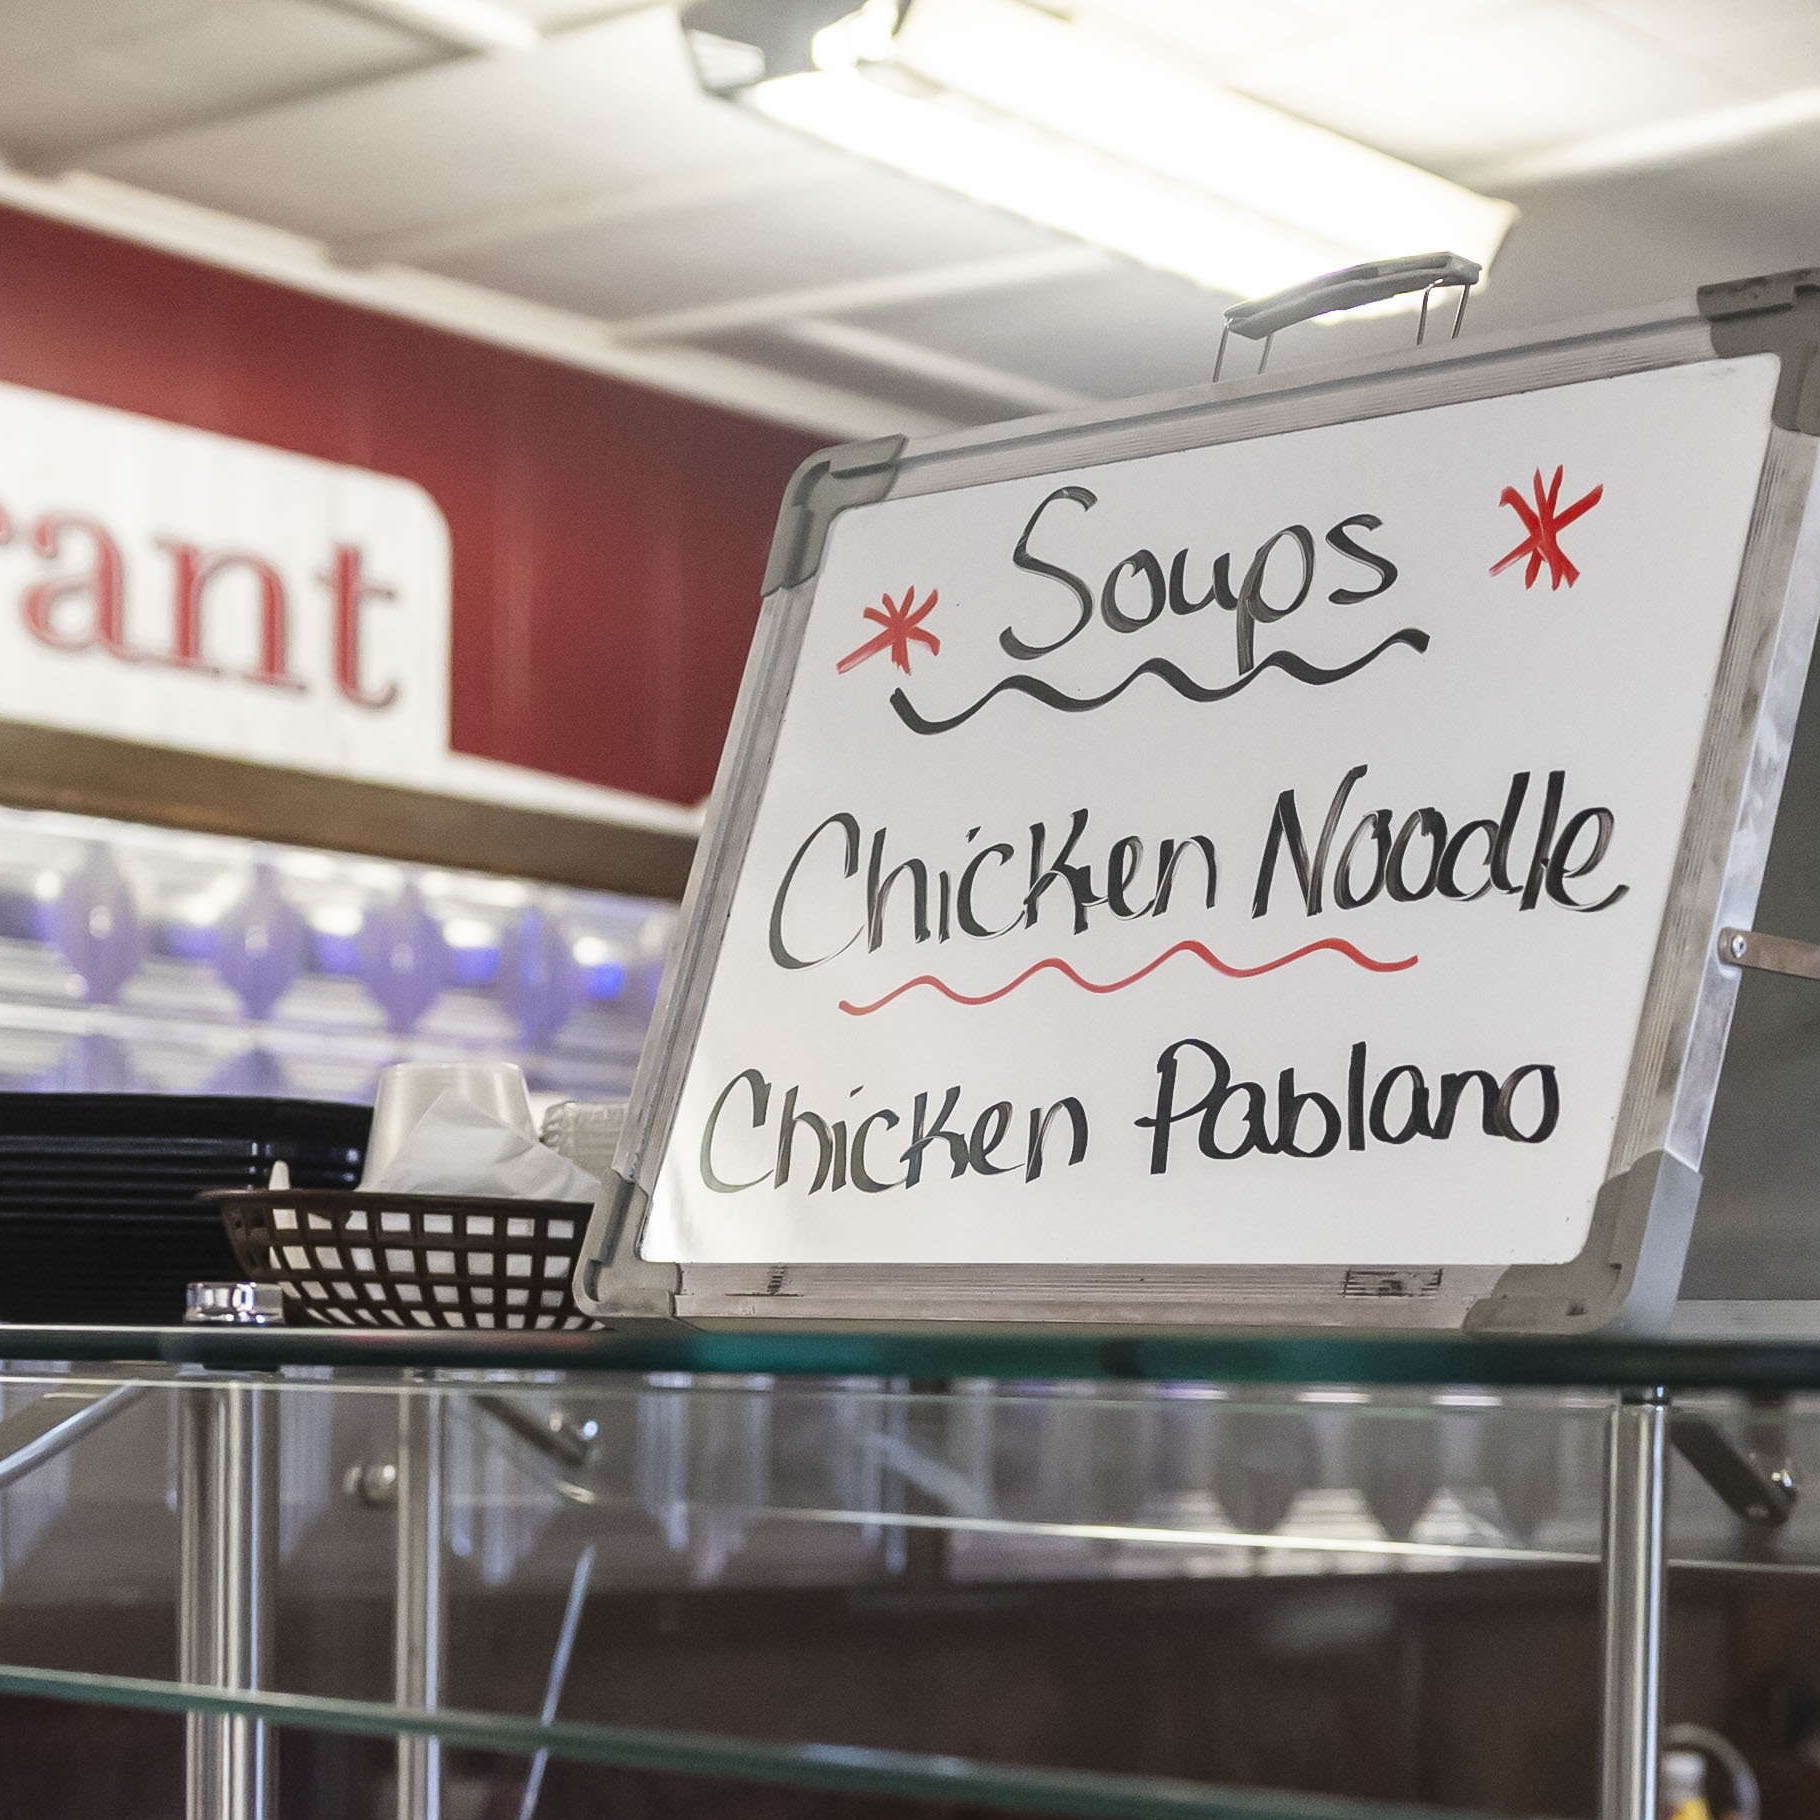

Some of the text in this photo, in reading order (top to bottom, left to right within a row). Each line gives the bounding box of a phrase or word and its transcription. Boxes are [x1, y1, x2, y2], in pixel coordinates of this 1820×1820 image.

[998, 484, 1401, 678] Soups
[767, 762, 1631, 972] Chicken Noodle
[698, 1037, 1563, 1197] Chicken Pablano
